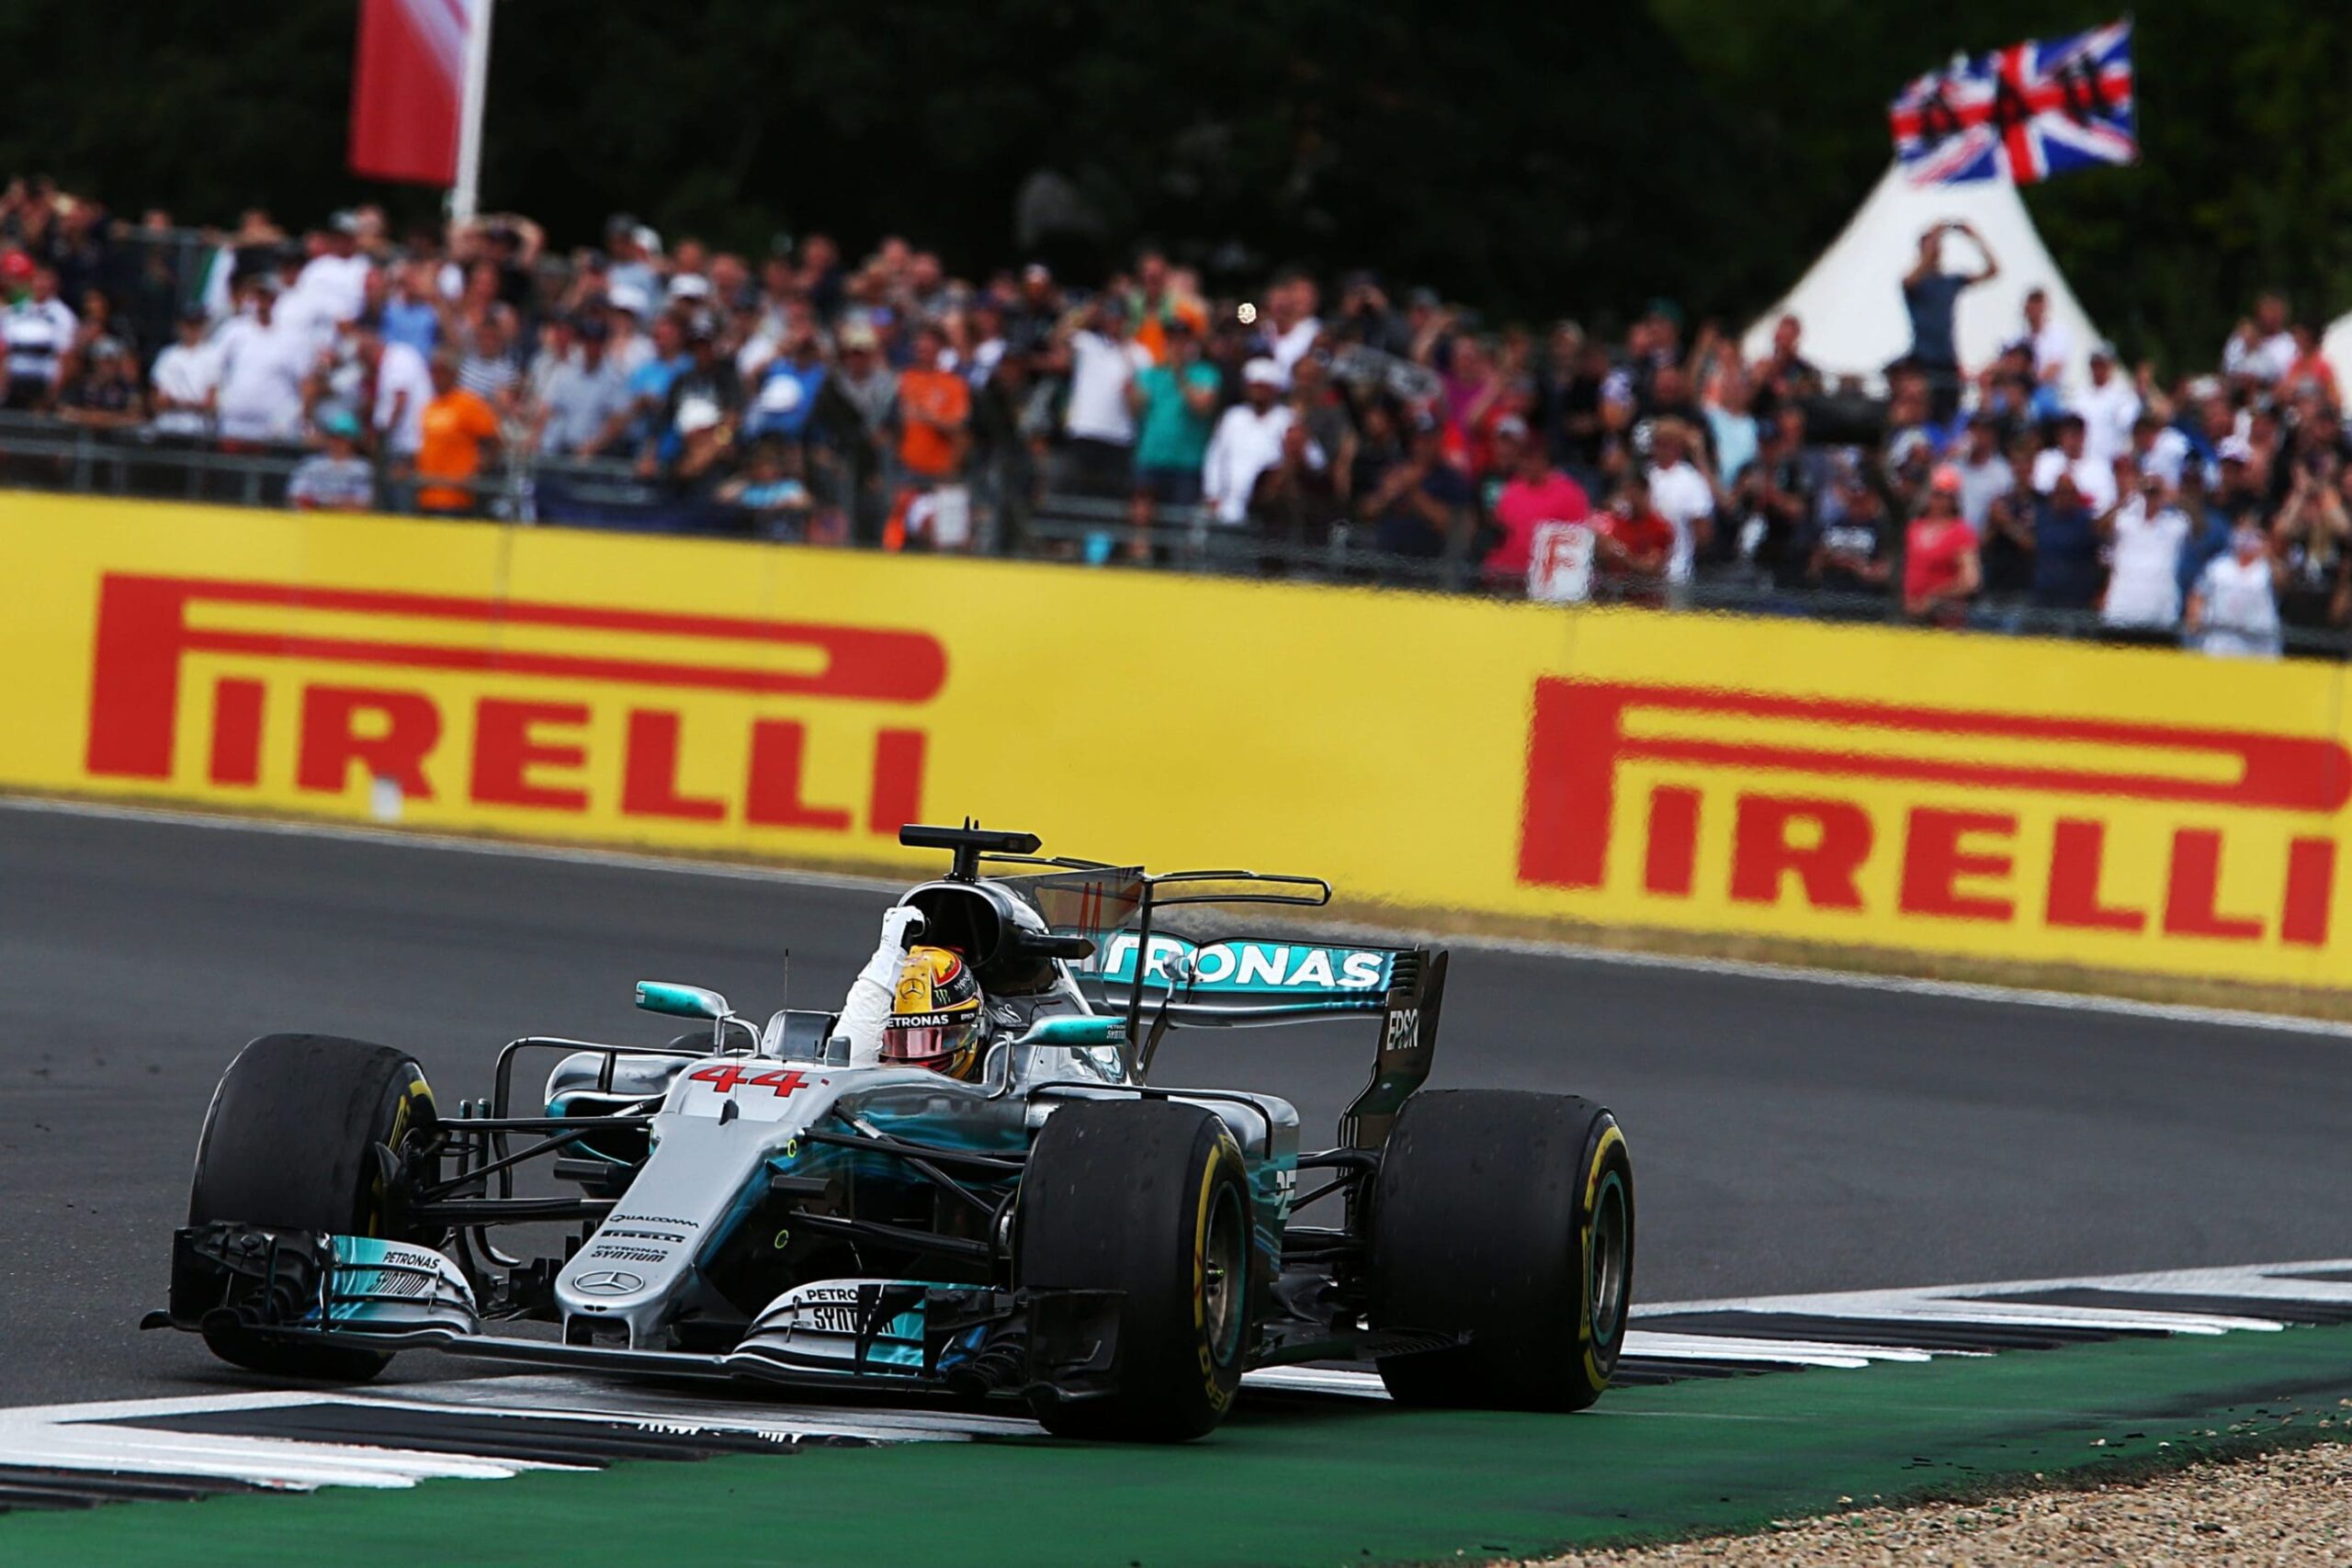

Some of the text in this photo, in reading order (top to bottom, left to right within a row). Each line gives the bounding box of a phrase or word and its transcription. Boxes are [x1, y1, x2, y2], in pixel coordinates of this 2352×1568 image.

[85, 571, 948, 835] PIRELLI
[1517, 675, 2352, 948] PIRELLI
[888, 1014, 949, 1028] ETRONAS
[689, 1064, 810, 1098] 44
[601, 1229, 686, 1244] PIRELLI
[591, 1250, 666, 1263] SYNTIUM
[596, 1245, 669, 1255] PETRONAS
[383, 1251, 440, 1269] PETRONAS
[807, 1289, 859, 1301] PETRO
